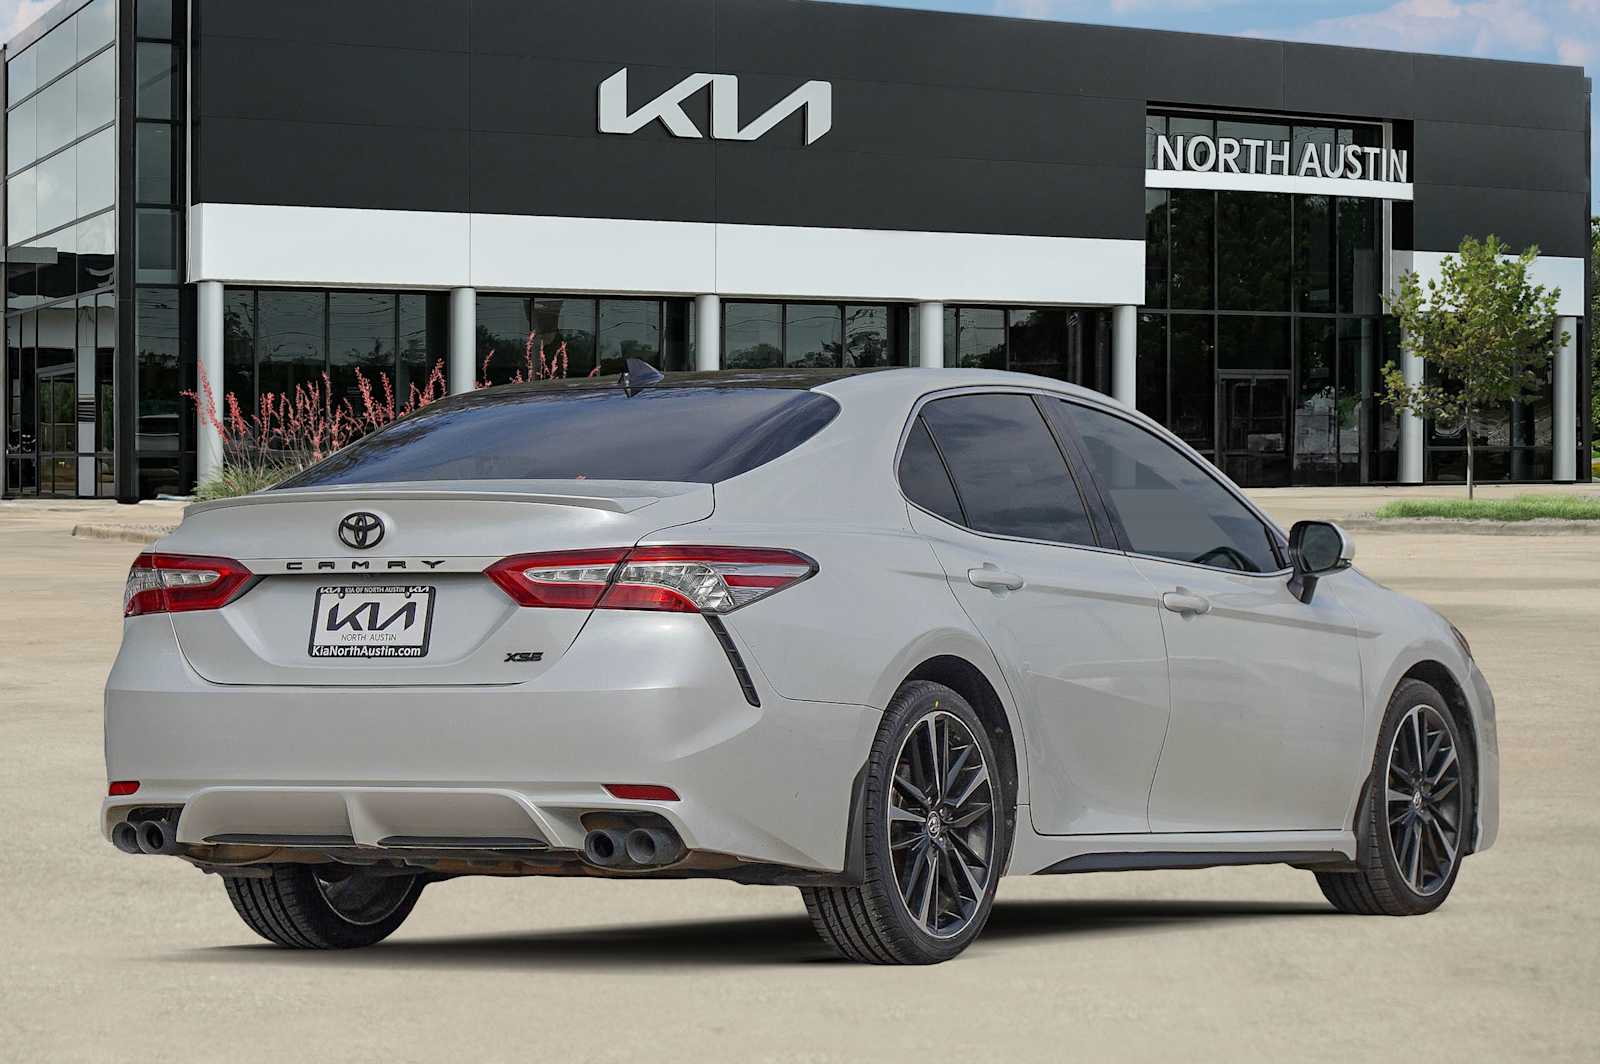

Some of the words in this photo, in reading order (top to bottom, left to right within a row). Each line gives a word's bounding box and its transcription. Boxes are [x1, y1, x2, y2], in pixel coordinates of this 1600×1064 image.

[598, 67, 833, 146] KIA
[1156, 134, 1290, 176] NORTH
[1298, 142, 1408, 183] AUSTIN
[286, 560, 446, 570] CAMRY
[326, 602, 417, 631] KIA
[341, 634, 366, 642] NORTH
[369, 634, 397, 642] AUSTIN
[312, 645, 421, 657] KiaNorthAustin.com
